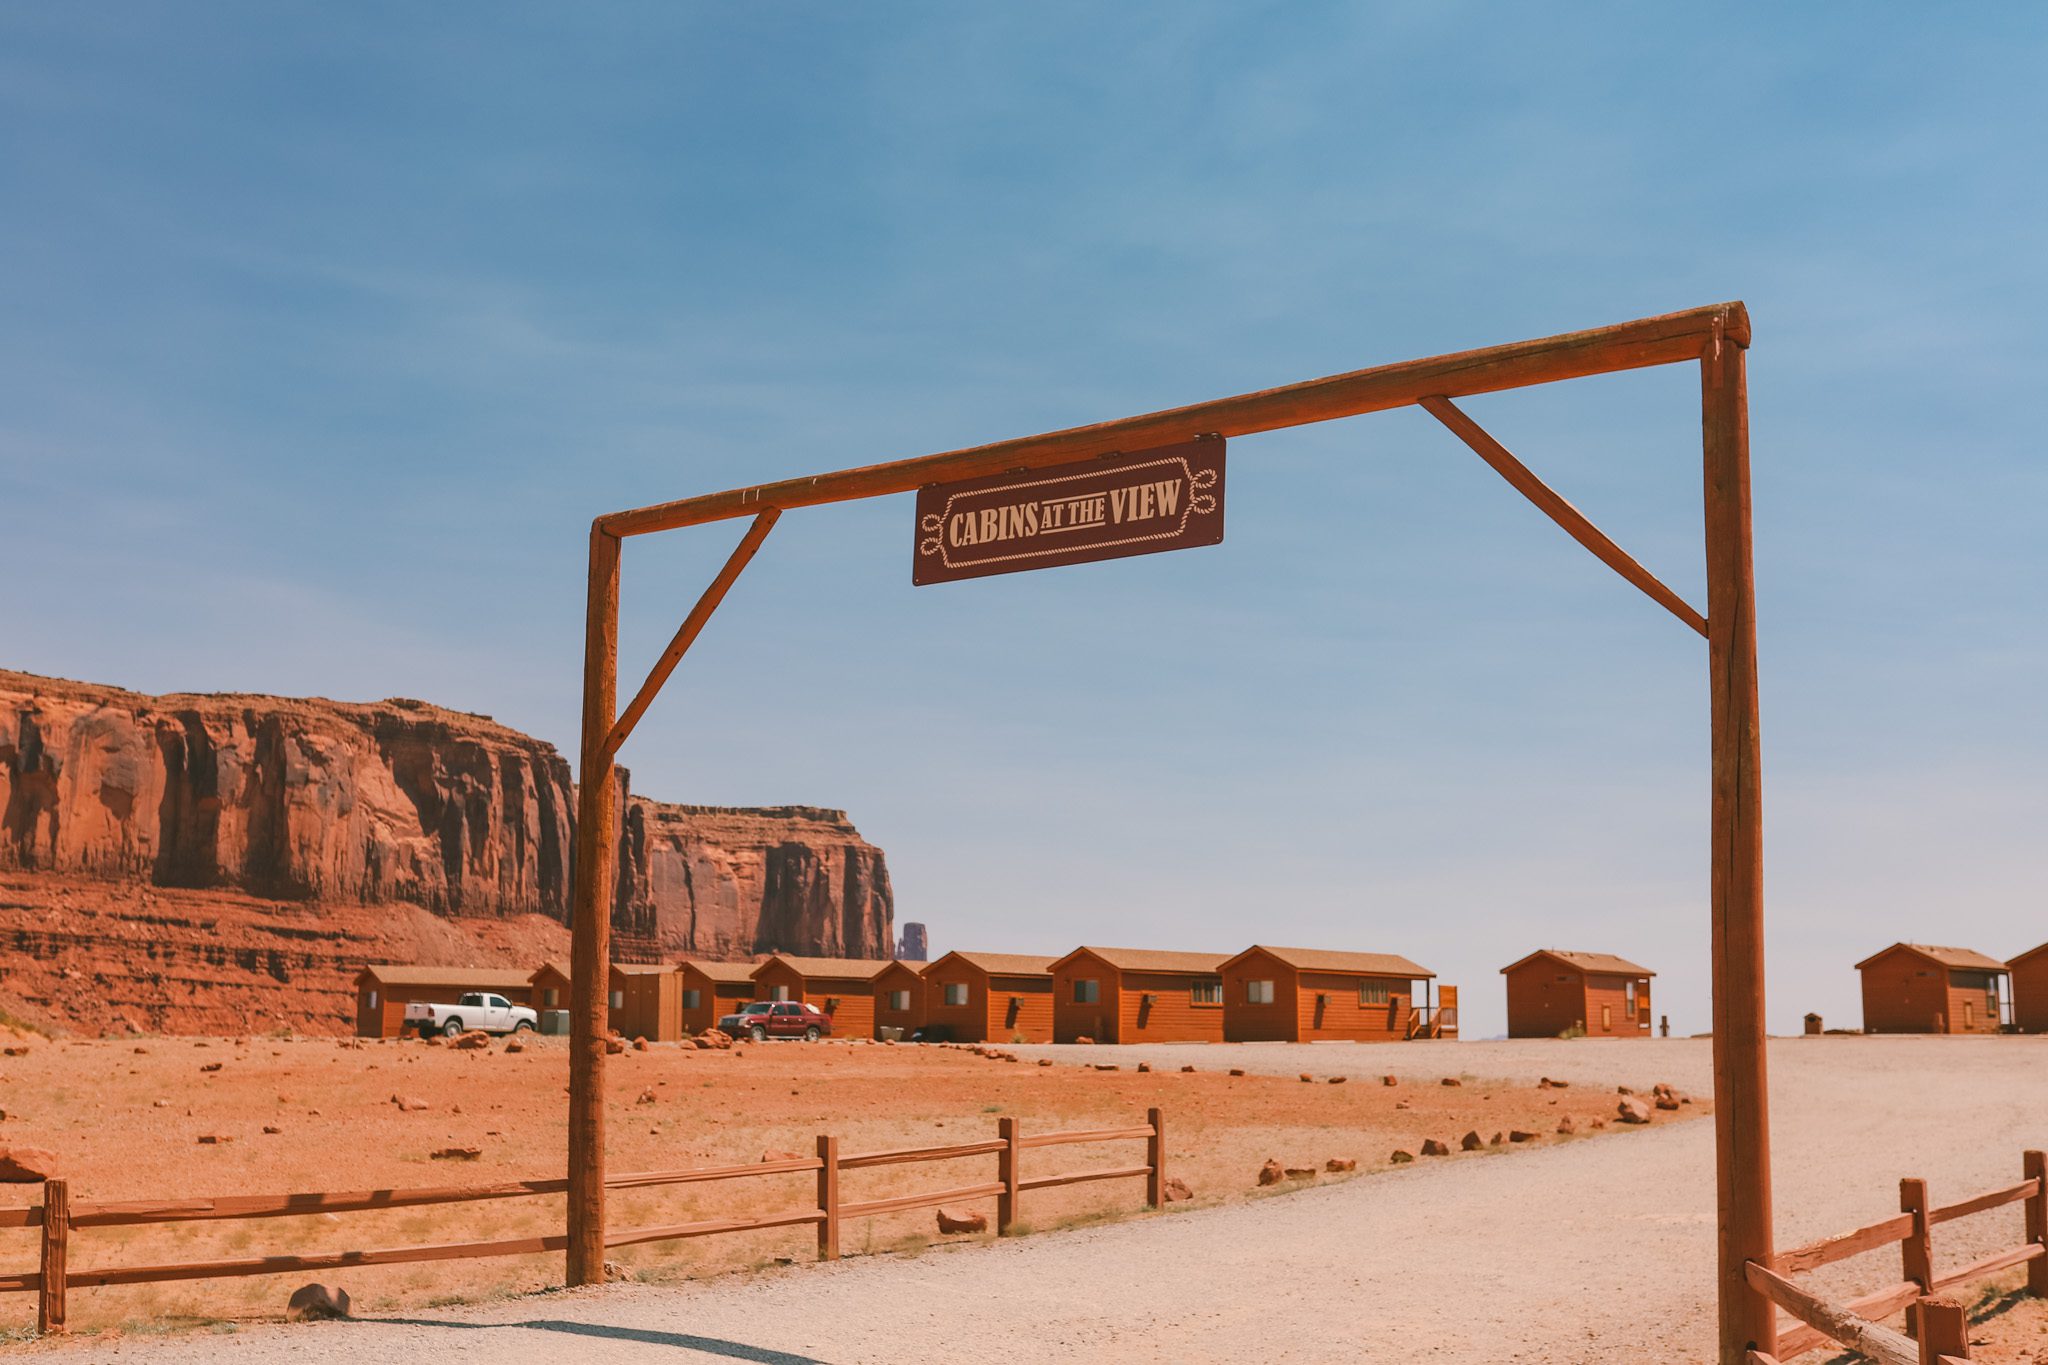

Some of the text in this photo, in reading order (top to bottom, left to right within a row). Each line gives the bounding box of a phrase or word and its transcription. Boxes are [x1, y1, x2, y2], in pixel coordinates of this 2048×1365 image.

[950, 479, 1182, 547] CABINS AT THE VIEW
